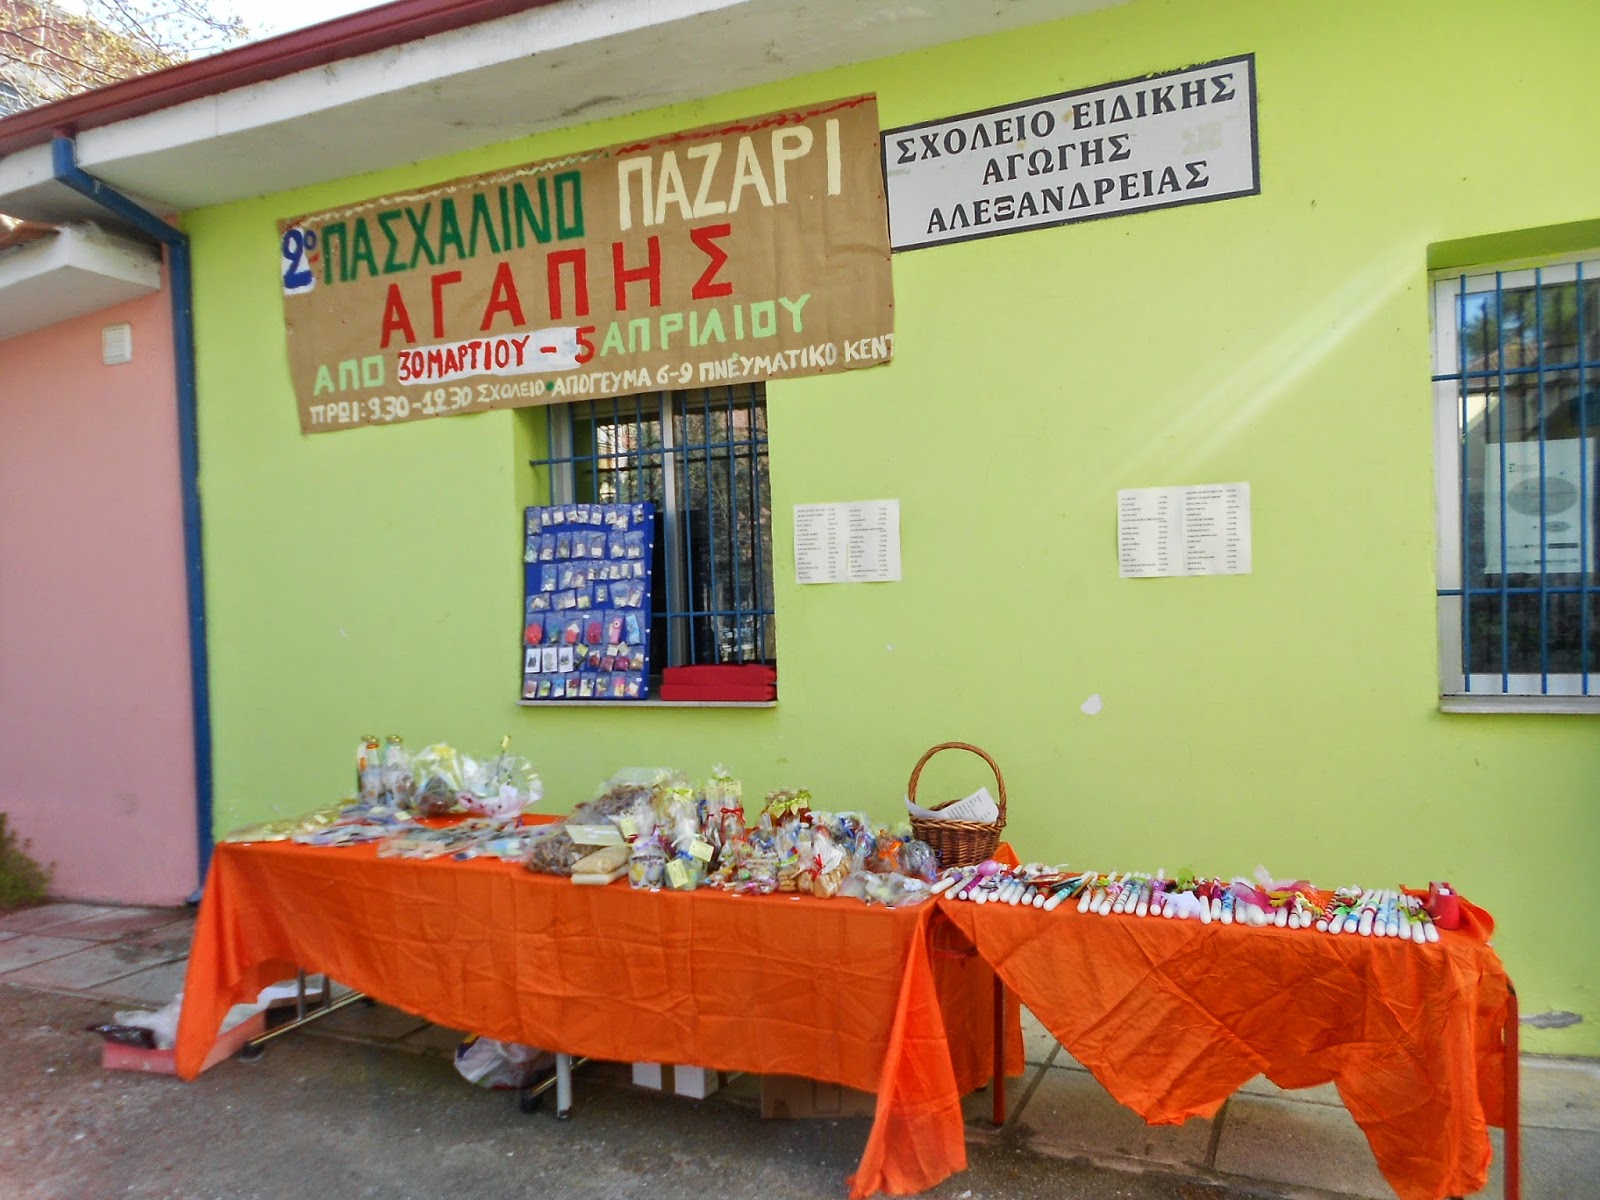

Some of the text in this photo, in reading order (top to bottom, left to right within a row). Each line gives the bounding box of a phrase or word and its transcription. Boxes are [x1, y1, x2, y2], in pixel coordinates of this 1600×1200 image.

[896, 72, 1236, 164] ΣΧΟΛΕΙΟ ΕΙΔΙΚΗΣ
[982, 133, 1132, 186] ΑΓΩΓΗΣ
[321, 170, 584, 285] ΠΑΣΧΑΛΙΝΟ
[617, 118, 842, 231] ΠΑΖΑΡΙ
[926, 160, 1209, 234] ΑΛΕΞΑΝΔΡΕΙΑΣ
[380, 223, 733, 348] ΑΓΑΠΗΣ
[313, 354, 385, 396] ΑΠΟ
[600, 293, 811, 357] ΑΠΡΙΛΙΟΥ
